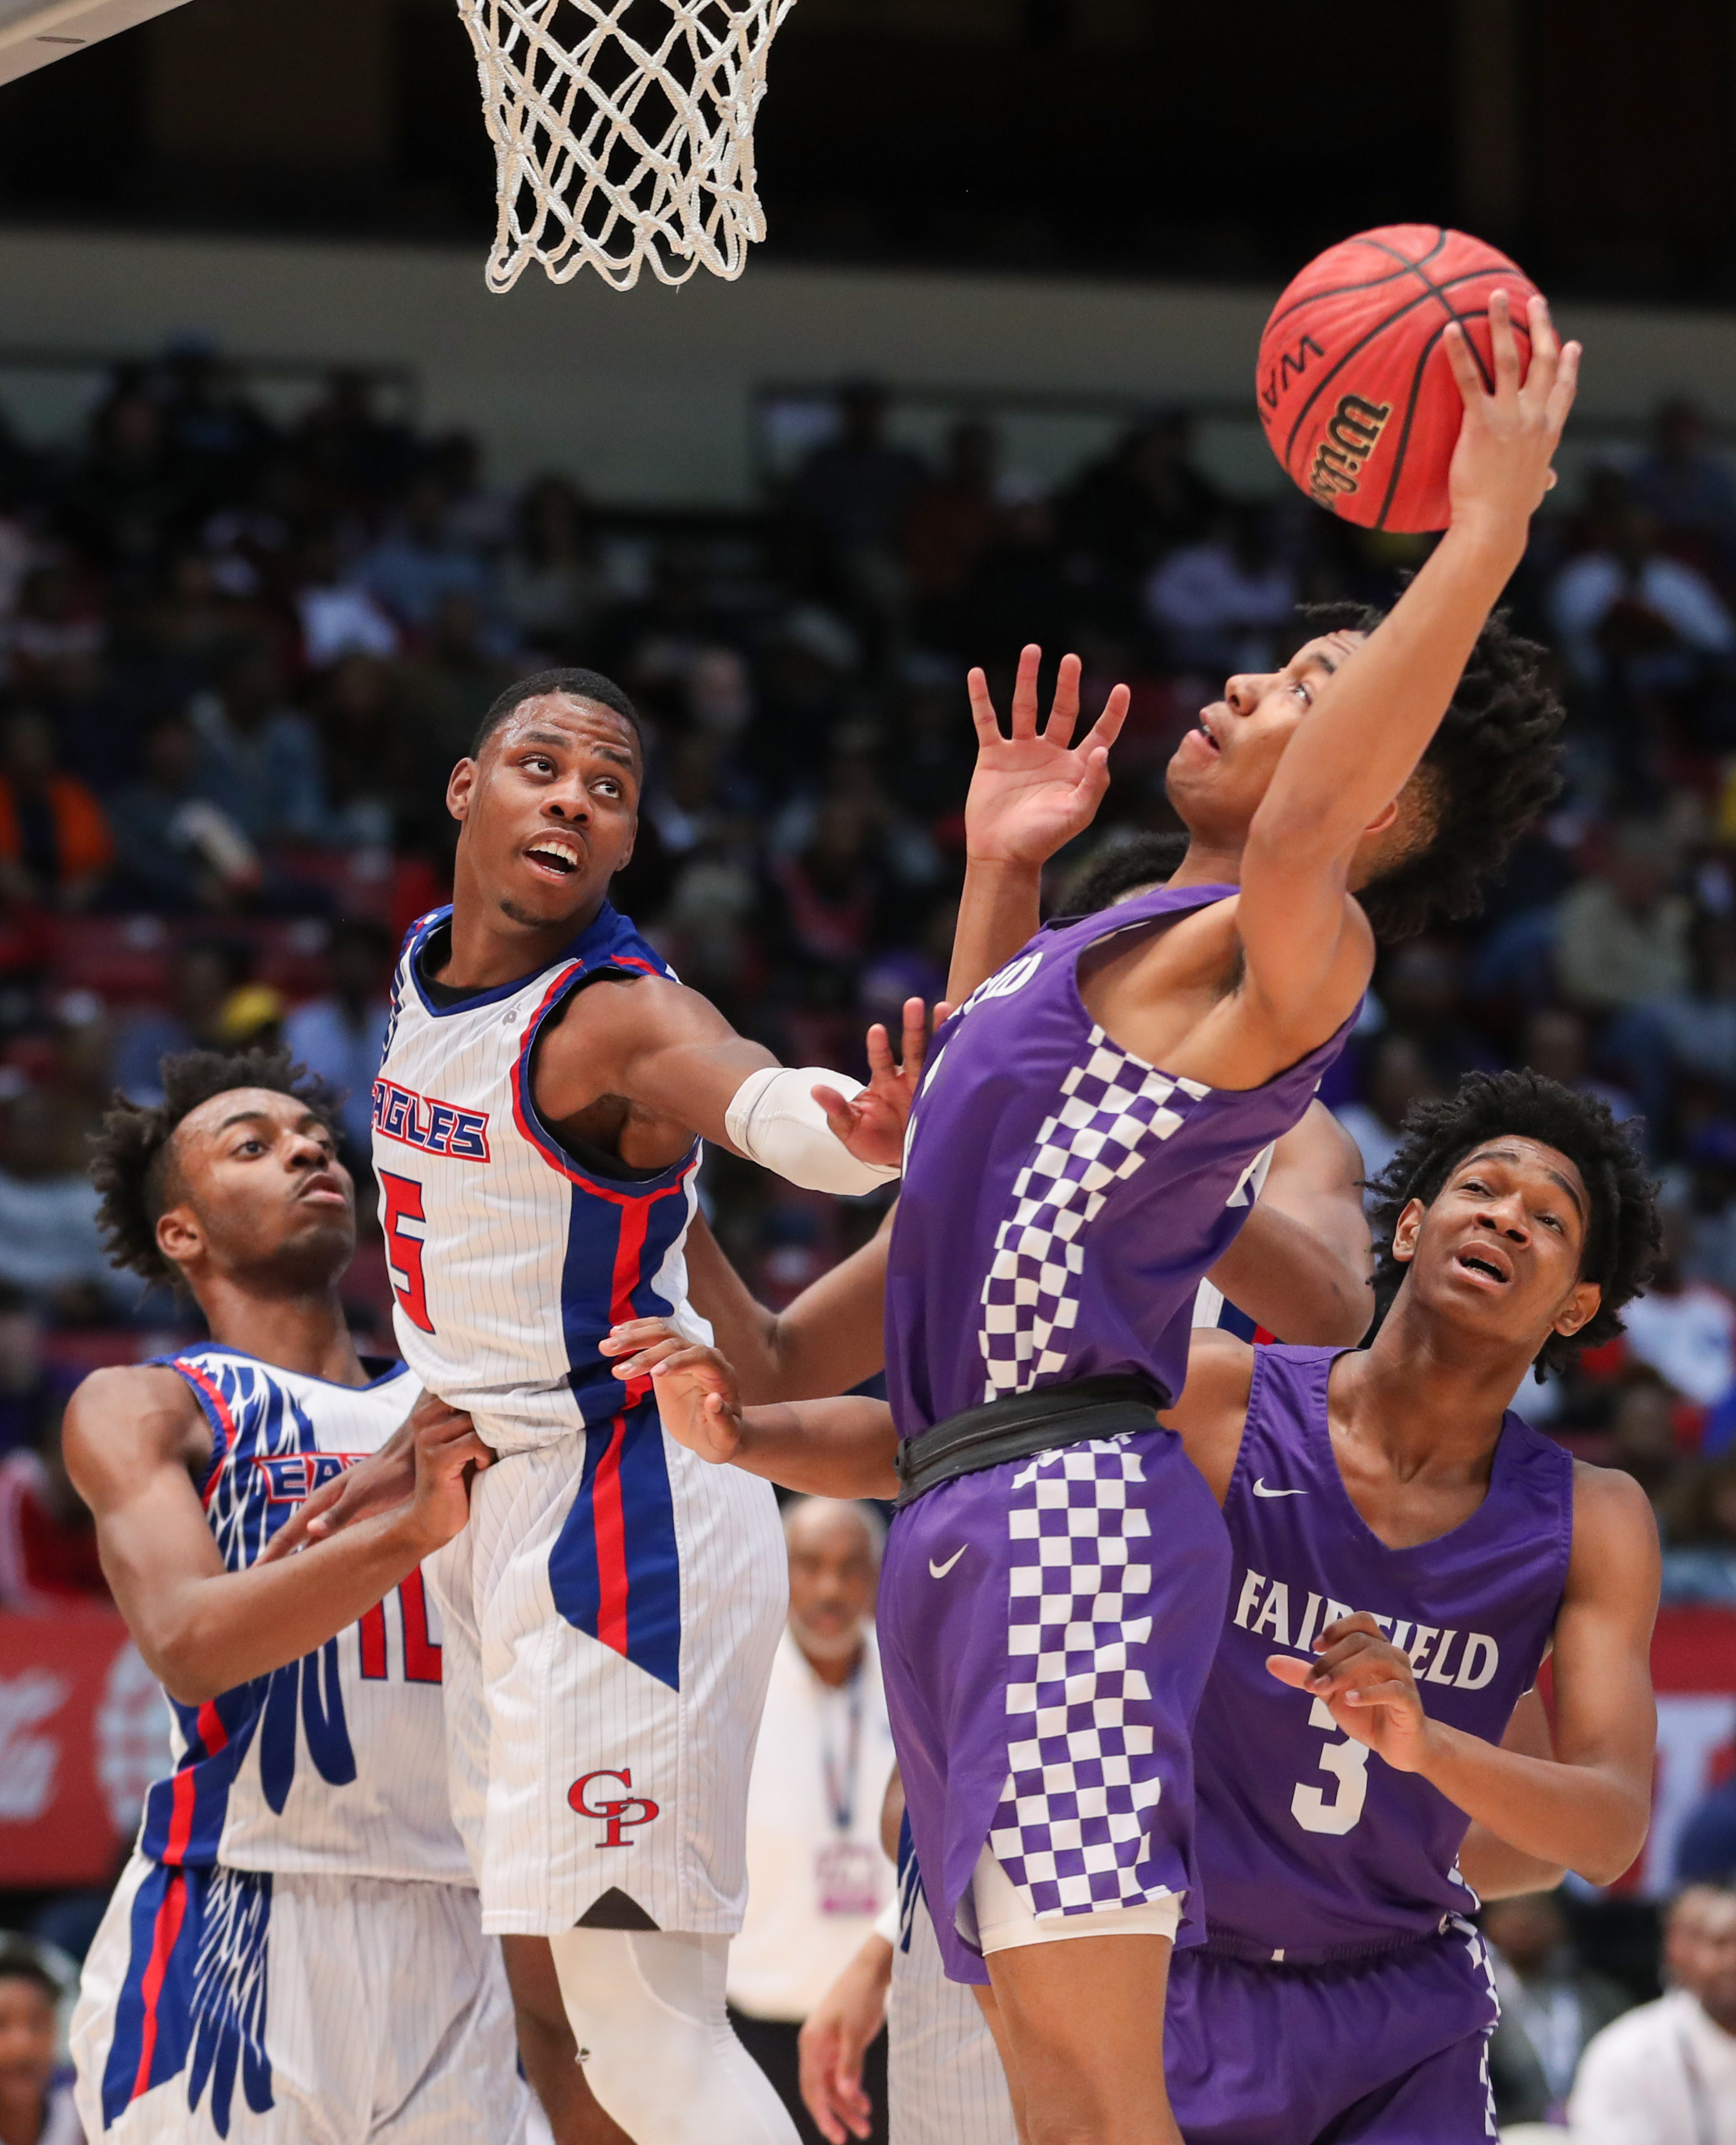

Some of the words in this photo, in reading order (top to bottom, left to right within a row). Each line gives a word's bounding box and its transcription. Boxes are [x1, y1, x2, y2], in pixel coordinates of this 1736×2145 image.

[1257, 335, 1324, 426] WA
[370, 1077, 491, 1164] AGLES
[377, 1167, 436, 1335] 5
[1233, 1568, 1499, 1690] FAIIELD
[1291, 1696, 1370, 1836] 3
